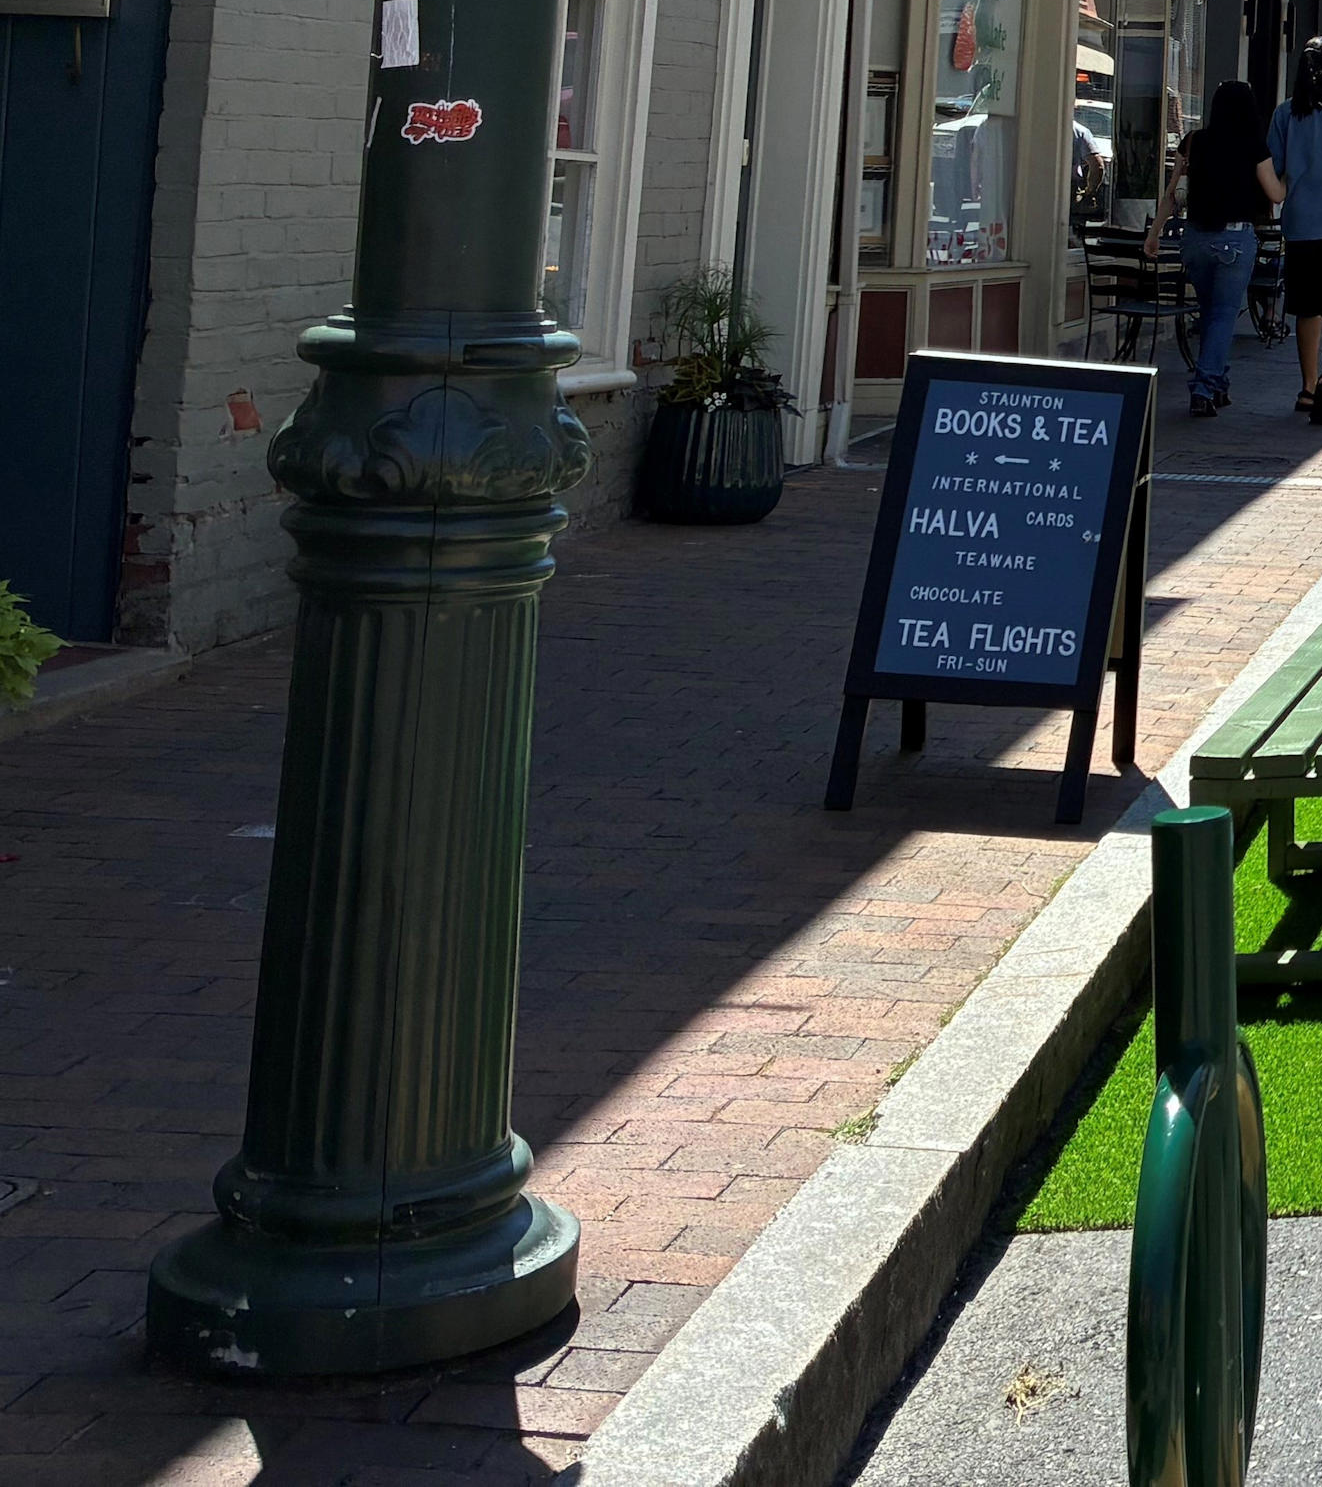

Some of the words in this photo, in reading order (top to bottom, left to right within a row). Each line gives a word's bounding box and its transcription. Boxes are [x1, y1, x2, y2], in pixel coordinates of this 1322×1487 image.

[979, 392, 1064, 410] STAUNTON
[934, 408, 1021, 439] BOOKS
[1031, 416, 1050, 441] &
[1056, 417, 1109, 445] TEA
[932, 475, 1082, 500] INTERNATIONAL
[909, 507, 999, 539] HALVA
[1026, 511, 1074, 528] CARDS
[955, 551, 1036, 571] TEAWARE
[910, 586, 1003, 605] CHOCOLATE
[899, 619, 950, 648] TEA
[969, 624, 1077, 656] FLIGHTS
[937, 655, 1008, 673] FRI-SUN
